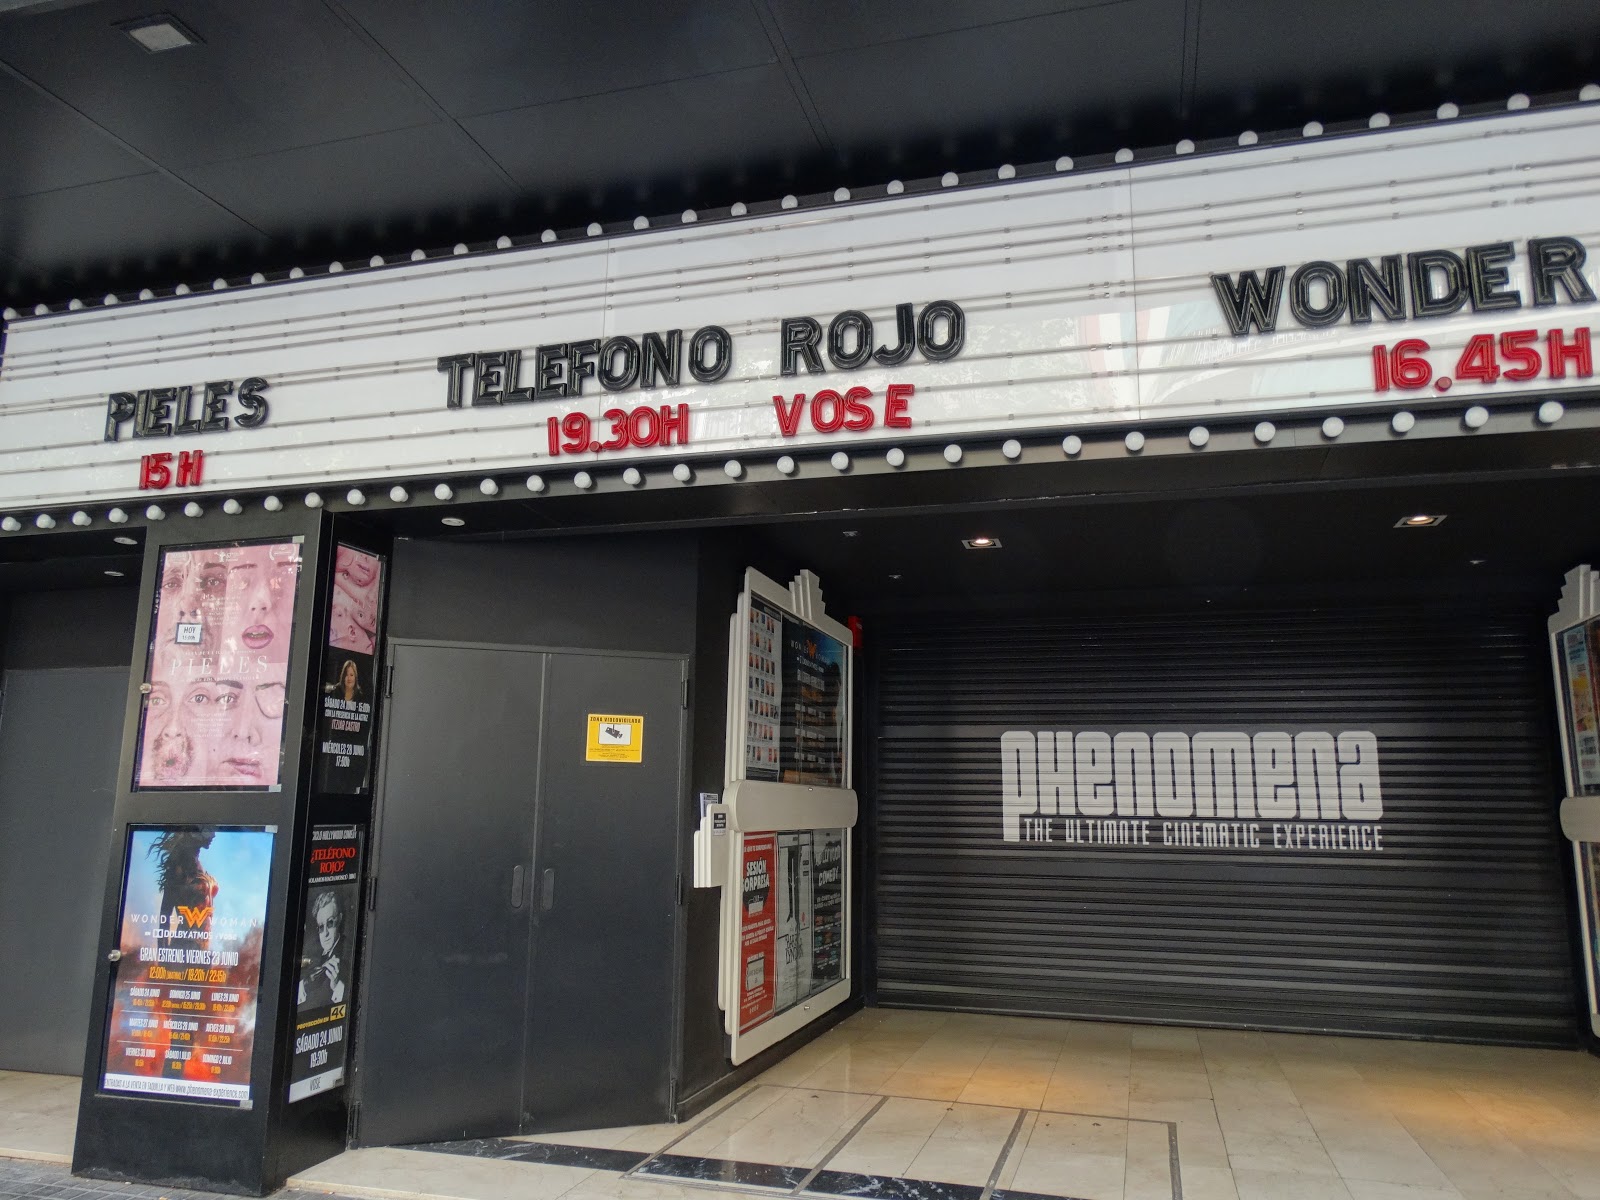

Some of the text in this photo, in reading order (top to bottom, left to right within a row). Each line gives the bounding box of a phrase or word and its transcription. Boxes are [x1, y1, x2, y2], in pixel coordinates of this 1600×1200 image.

[1210, 236, 1598, 336] WONDER
[437, 300, 967, 409] TELEFONO ROJO
[1371, 327, 1593, 391] 16.45H
[104, 377, 270, 442] PIELES
[547, 384, 915, 457] 19.30H VOSE
[170, 655, 268, 676] PIELES
[1024, 818, 1384, 851] THE ULTIMATE CINEMATIC EXPERIENCE
[320, 861, 345, 874] ROJO?
[746, 856, 766, 876] SESIÓN
[818, 866, 839, 887] COMEDY
[131, 914, 257, 928] WONDER WOMAN
[164, 930, 187, 939] DOLBY
[188, 931, 212, 940] ATMOS
[140, 946, 158, 962] GRAN
[186, 949, 211, 965] VIERNES
[221, 951, 239, 967] JUNIO
[296, 1026, 342, 1054] SÁBADO 24 JUNIO
